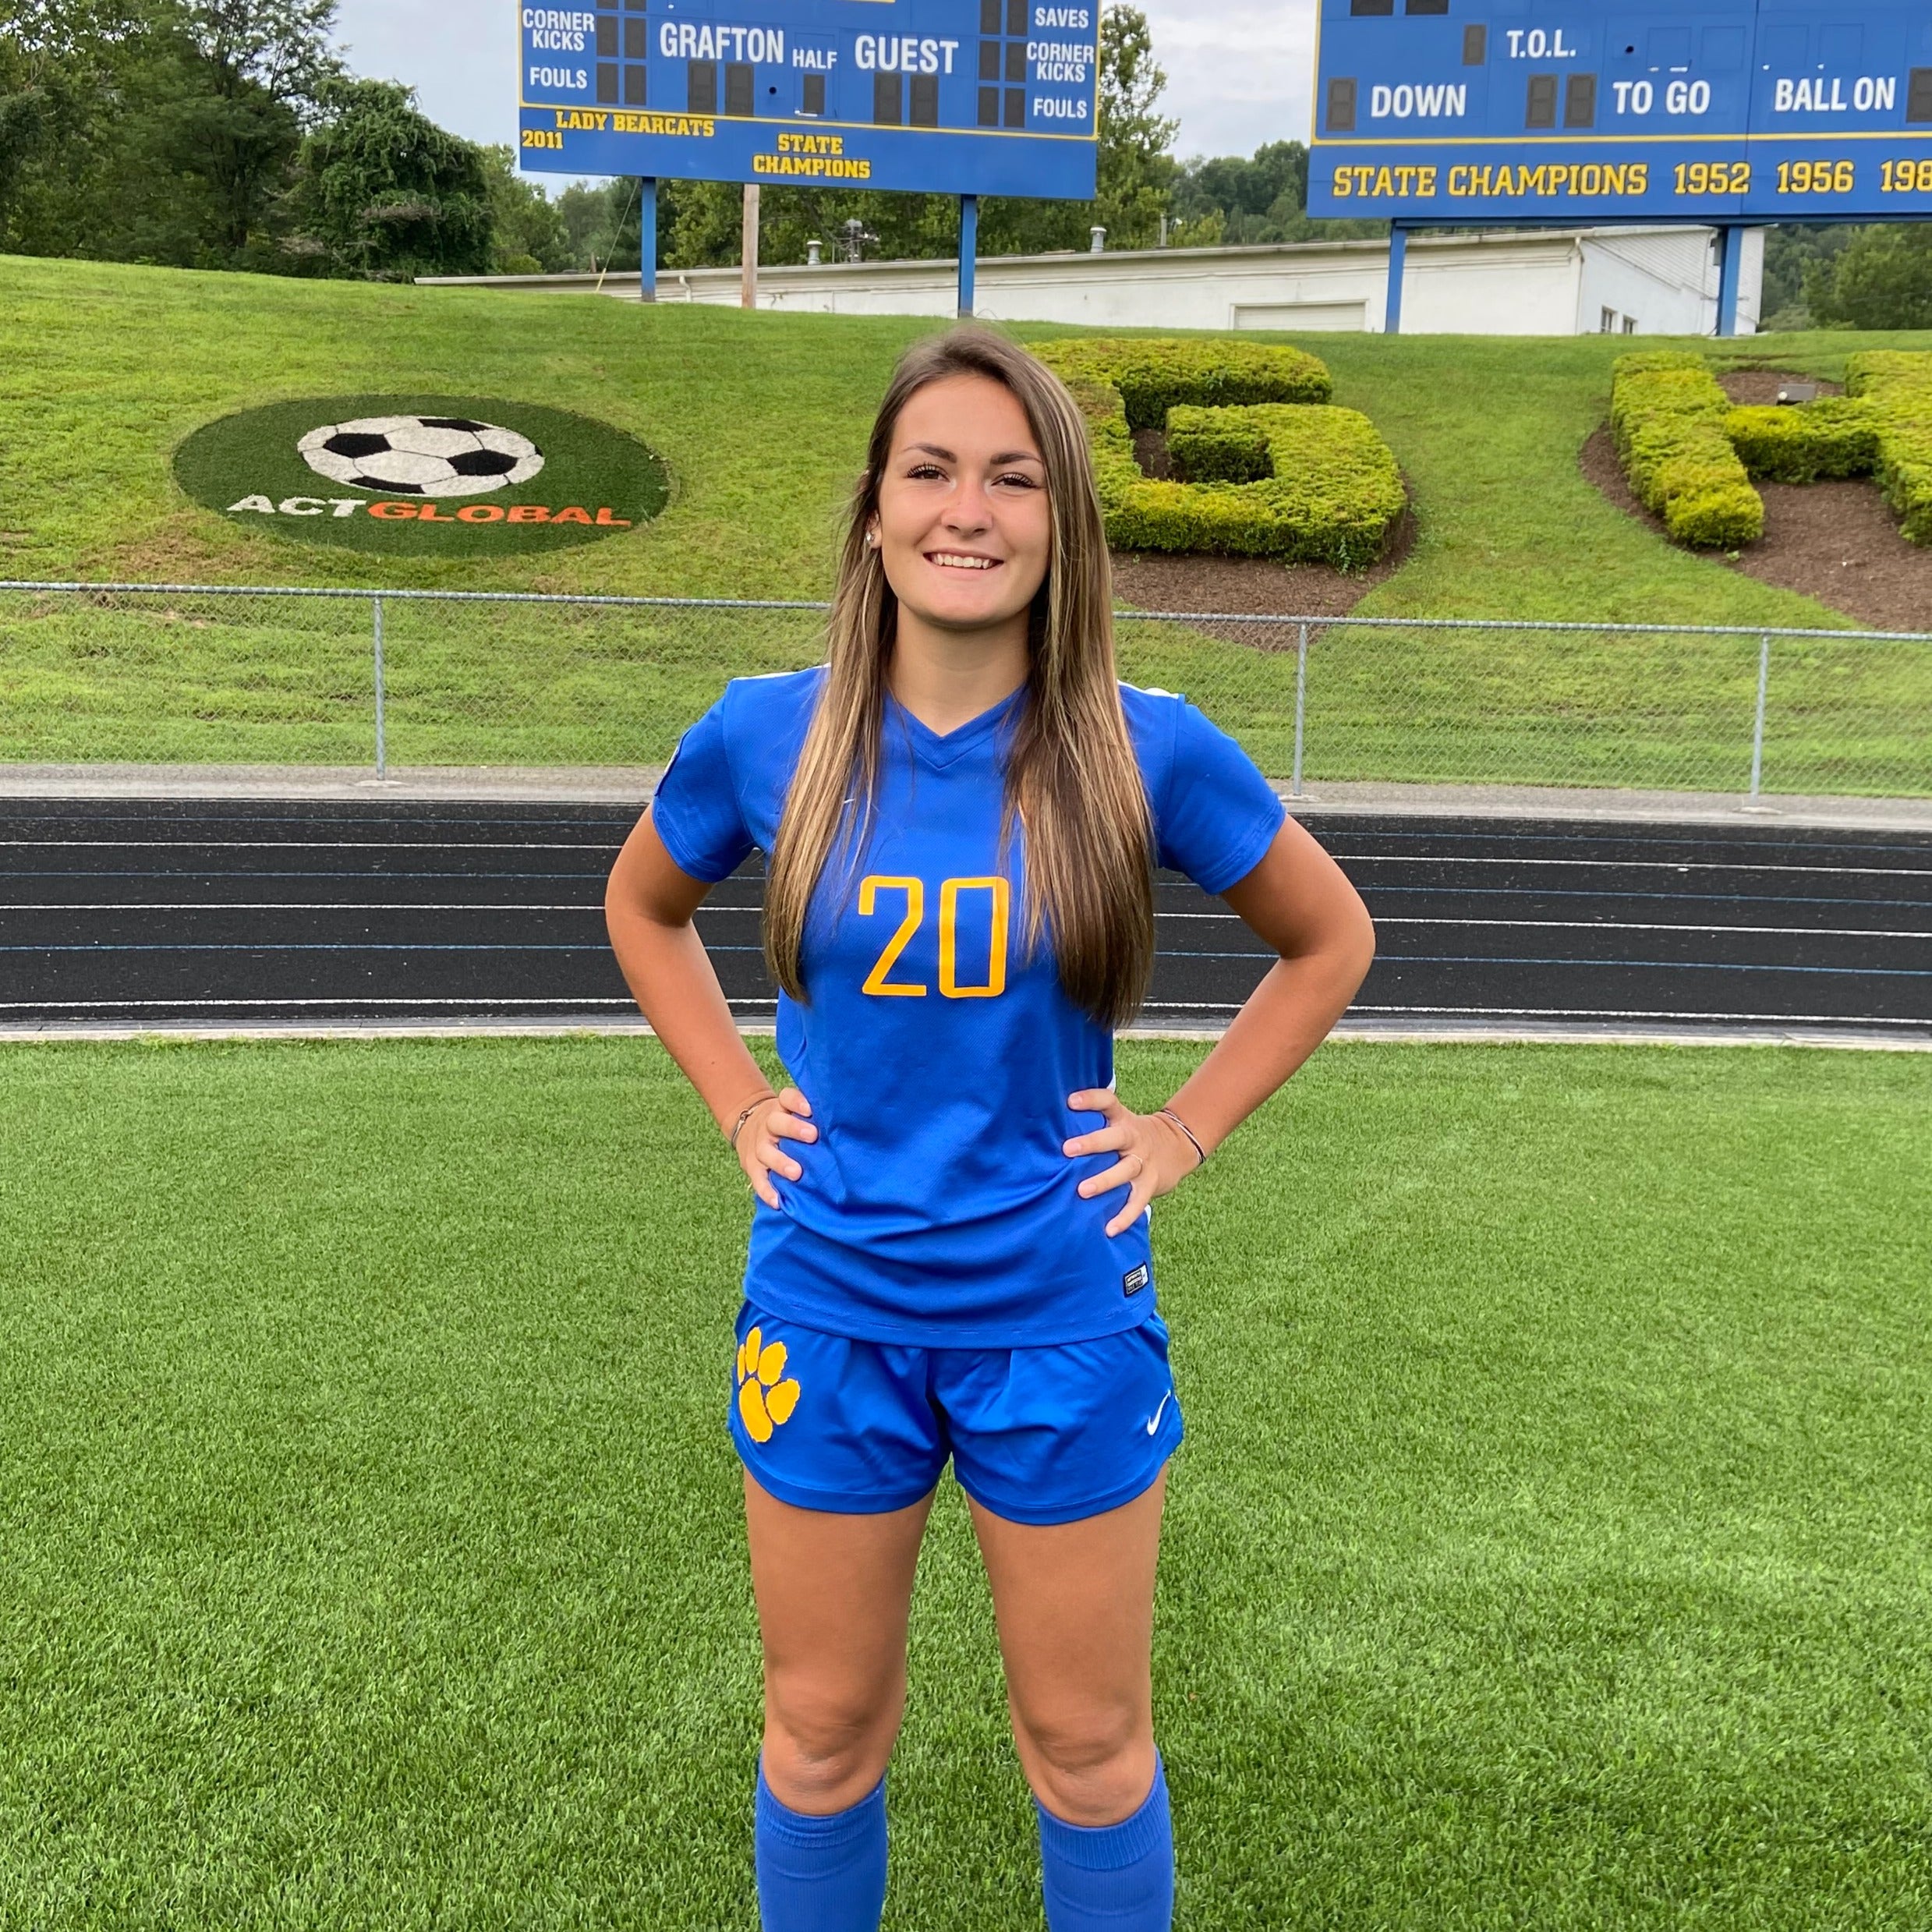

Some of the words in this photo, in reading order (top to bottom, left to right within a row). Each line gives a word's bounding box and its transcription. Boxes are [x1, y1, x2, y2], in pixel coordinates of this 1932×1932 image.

[522, 9, 595, 33] CORNER
[1035, 7, 1089, 29] SAVES
[532, 29, 586, 52] KICKS
[660, 22, 784, 64] GRAFTON
[792, 48, 837, 69] HALF
[855, 34, 959, 74] GUEST
[1026, 41, 1095, 64] CORNER
[1506, 29, 1576, 58] T.O.L.
[529, 66, 587, 90] FOULS
[1036, 61, 1086, 83] KICKS
[1371, 83, 1467, 119] DOWN
[1612, 80, 1653, 115] TO
[1665, 80, 1711, 115] GO
[1775, 77, 1847, 112] BALL
[1853, 76, 1896, 111] ON
[1032, 97, 1088, 119] FOULS
[555, 111, 607, 131] LADY
[613, 113, 716, 137] BEARCATS
[522, 129, 564, 150] 2011
[777, 133, 844, 156] STATE
[752, 154, 872, 179] CHAMPIONS
[1332, 165, 1437, 197] STATE
[1447, 163, 1648, 196] CHAMPIONS
[1674, 161, 1751, 194] 1952
[1777, 161, 1854, 193] 1956
[1881, 159, 1932, 193] 198
[858, 875, 1010, 999] 20
